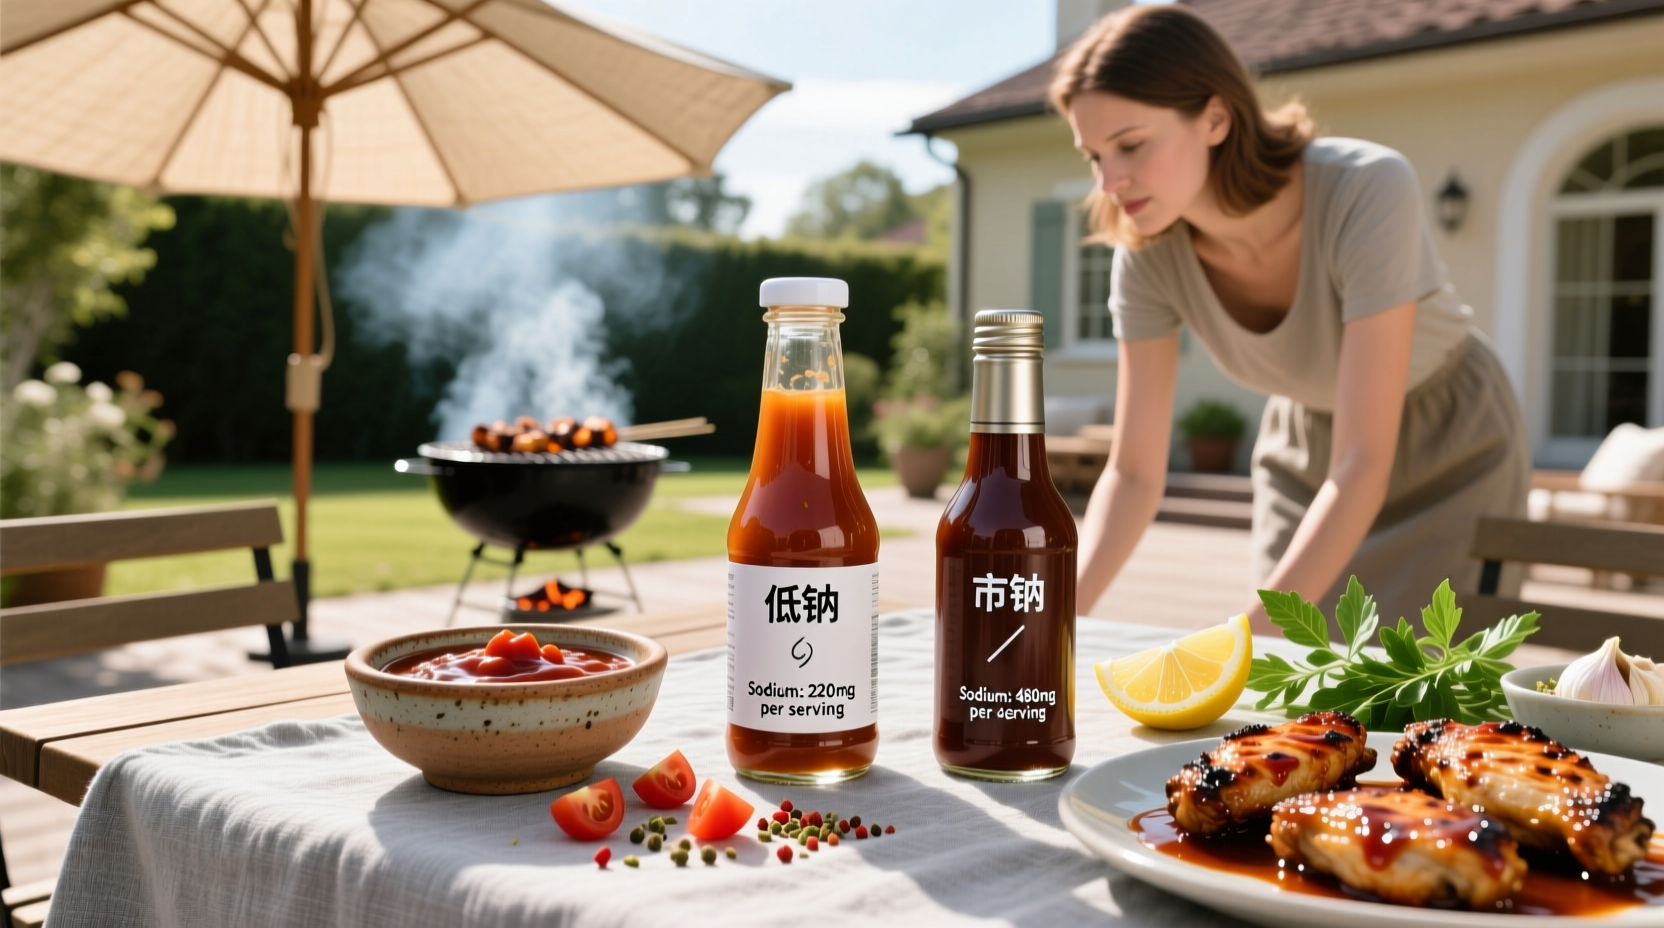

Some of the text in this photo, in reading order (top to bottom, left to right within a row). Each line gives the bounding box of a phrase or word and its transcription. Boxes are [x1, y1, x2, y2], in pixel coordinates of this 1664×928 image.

[972, 572, 1045, 613] 市钠
[764, 583, 839, 624] 低钠
[747, 680, 856, 700] Sodium: 220mg
[959, 685, 1012, 703] Sodium:
[760, 701, 845, 720] per serving
[969, 706, 993, 722] per
